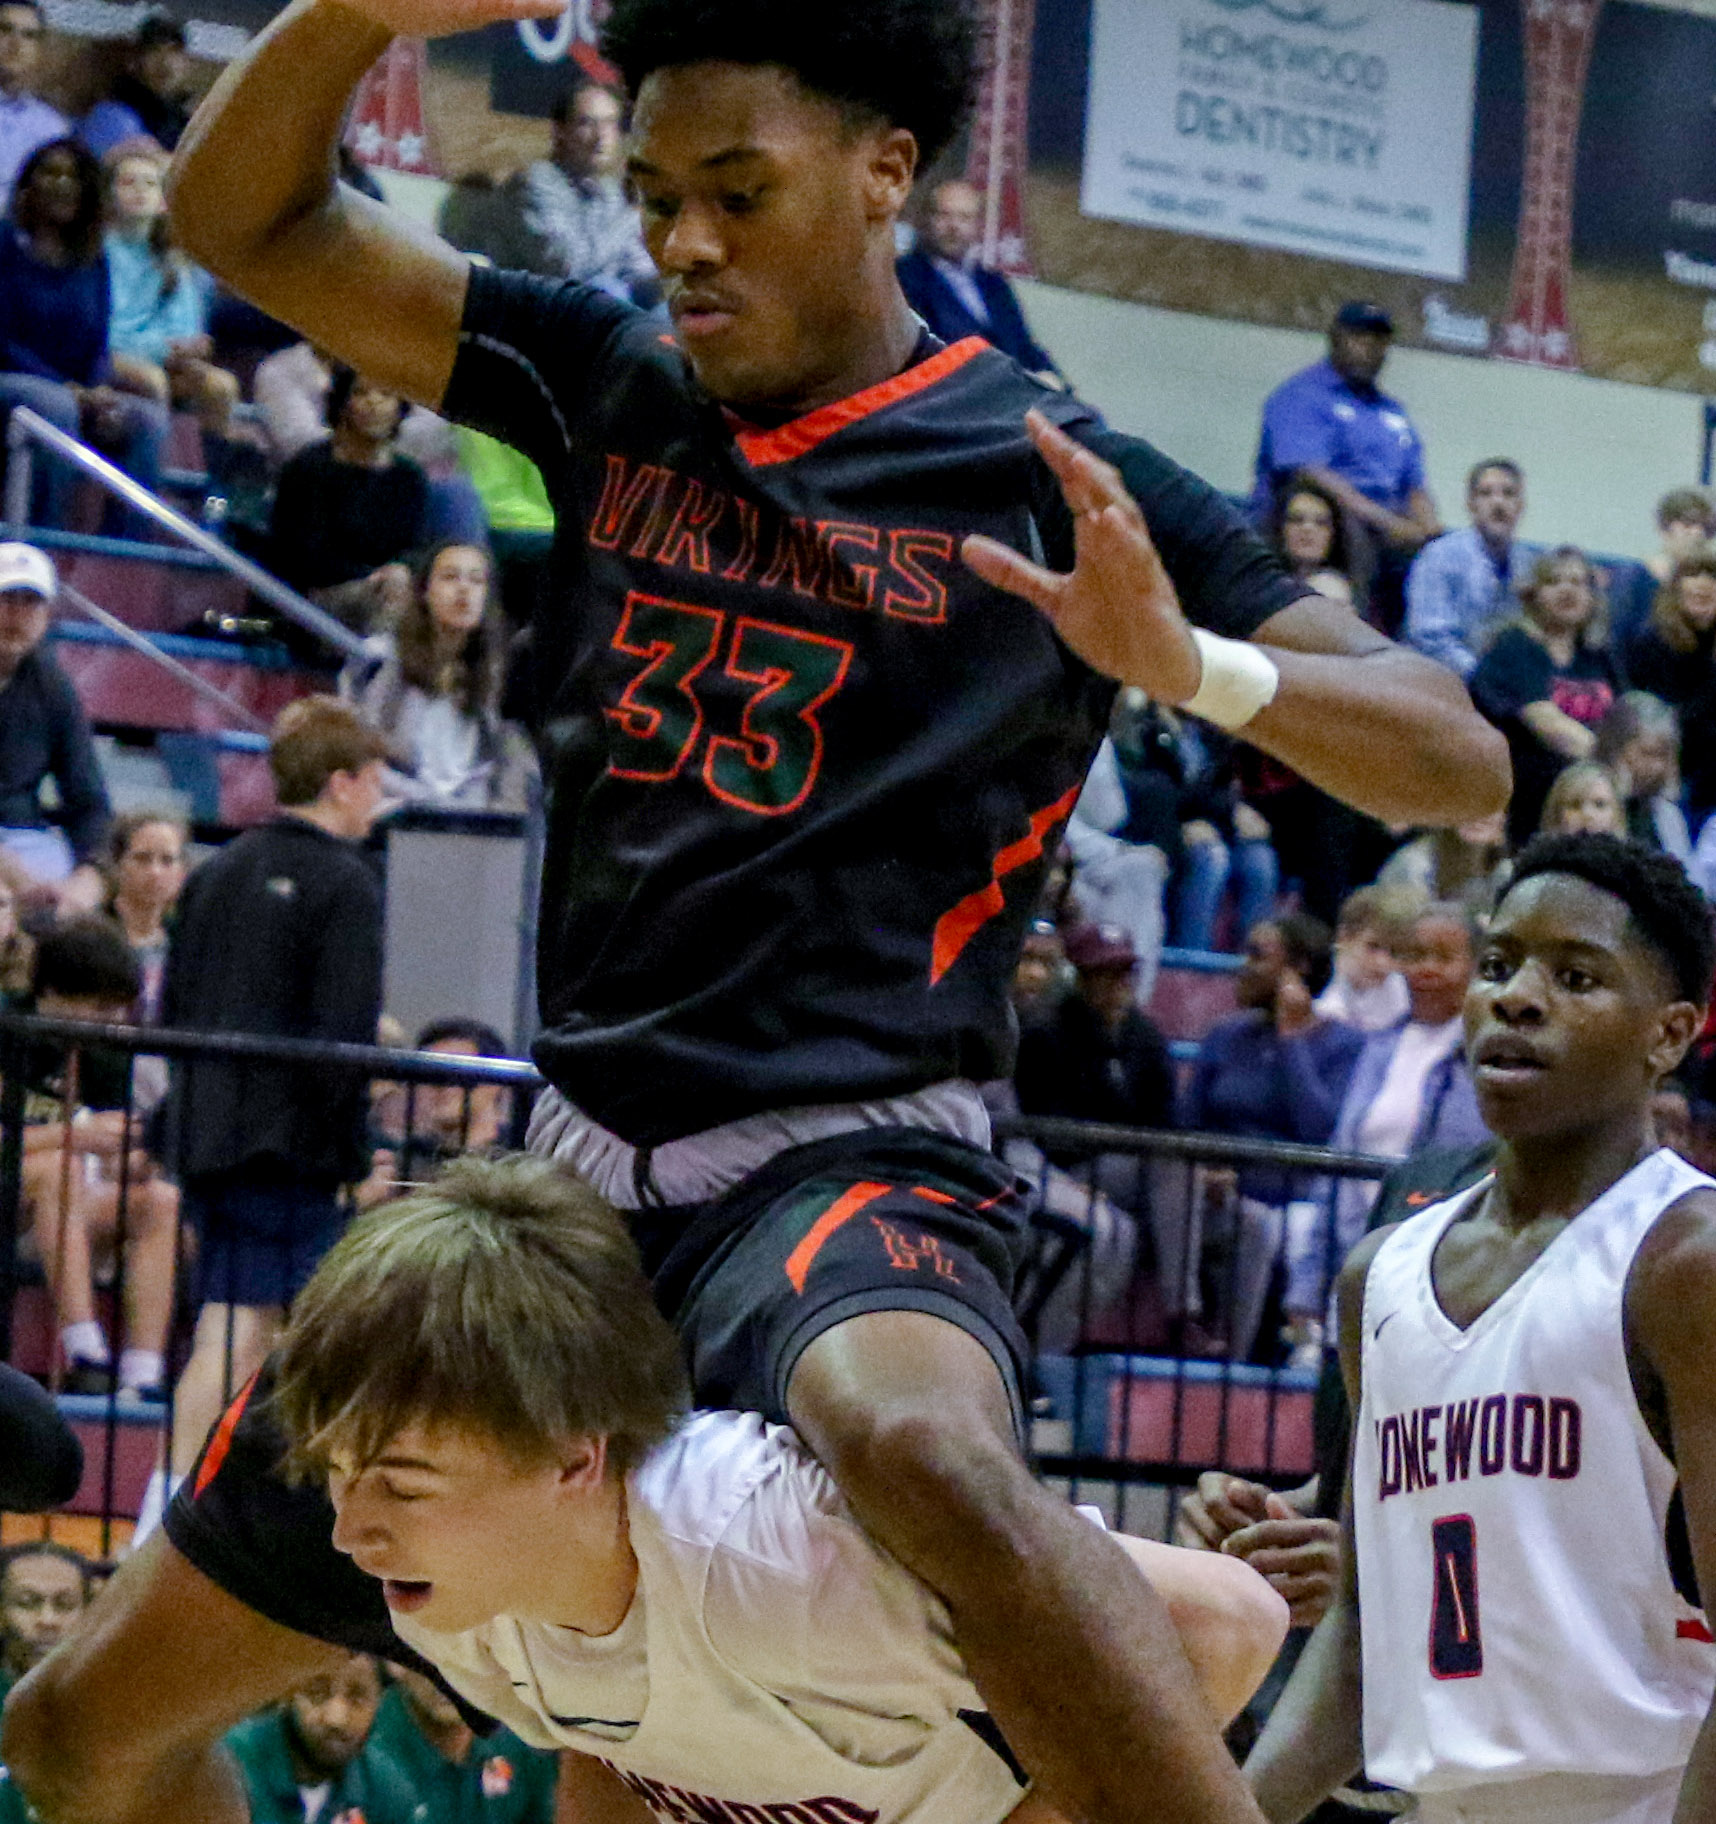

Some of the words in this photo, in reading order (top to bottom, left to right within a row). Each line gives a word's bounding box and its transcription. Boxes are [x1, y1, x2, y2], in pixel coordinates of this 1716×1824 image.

[1177, 20, 1389, 93] HOMEWOOD
[1174, 88, 1386, 171] DENTISTRY
[589, 453, 954, 624] VIKINGS
[602, 589, 854, 817] 33
